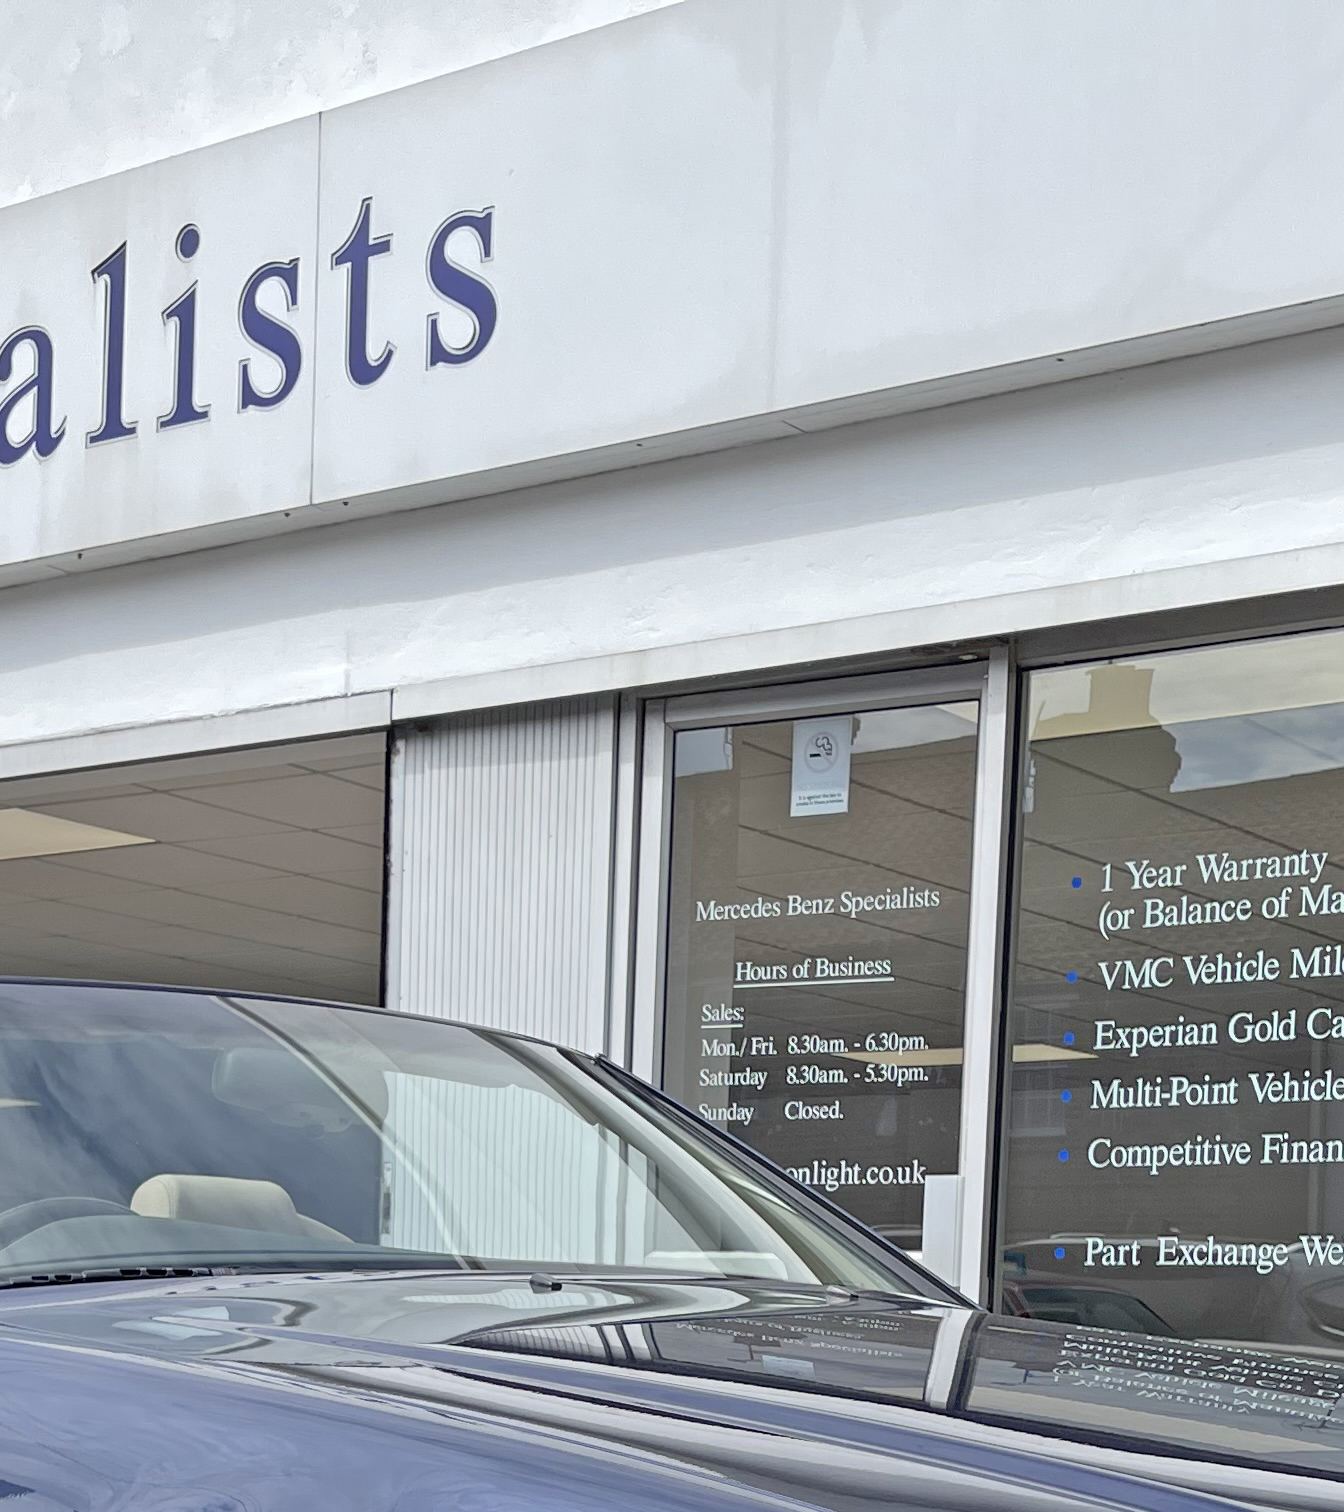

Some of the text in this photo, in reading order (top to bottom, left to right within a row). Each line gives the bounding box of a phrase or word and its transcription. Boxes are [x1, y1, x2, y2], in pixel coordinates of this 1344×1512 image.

[1101, 849, 1328, 892] 1 Year Warranty
[696, 887, 941, 921] Mercedes Benz Specialists
[1099, 901, 1134, 940] (or
[1142, 896, 1252, 928] Balance
[1262, 887, 1292, 918] of
[736, 956, 891, 981] Hours of Business
[1098, 957, 1173, 990] VMC
[1182, 950, 1280, 985] Vehicle
[701, 1004, 744, 1022] Sales:
[750, 1036, 777, 1055] Fri.
[788, 1036, 848, 1054] 8.30am.
[866, 1032, 928, 1055] 6.30pm.
[1093, 1016, 1218, 1057] Experian
[1229, 1010, 1296, 1043] Gold
[699, 1067, 768, 1090] Saturday
[787, 1065, 848, 1084] 8.30am.
[865, 1064, 928, 1087] 5.30pm.
[1090, 1075, 1238, 1109] Multi-Point
[699, 1100, 843, 1125] Sunday Closed.
[1088, 1135, 1251, 1175] Competitive
[1084, 1238, 1142, 1268] Part
[1156, 1238, 1288, 1276] Exchange
